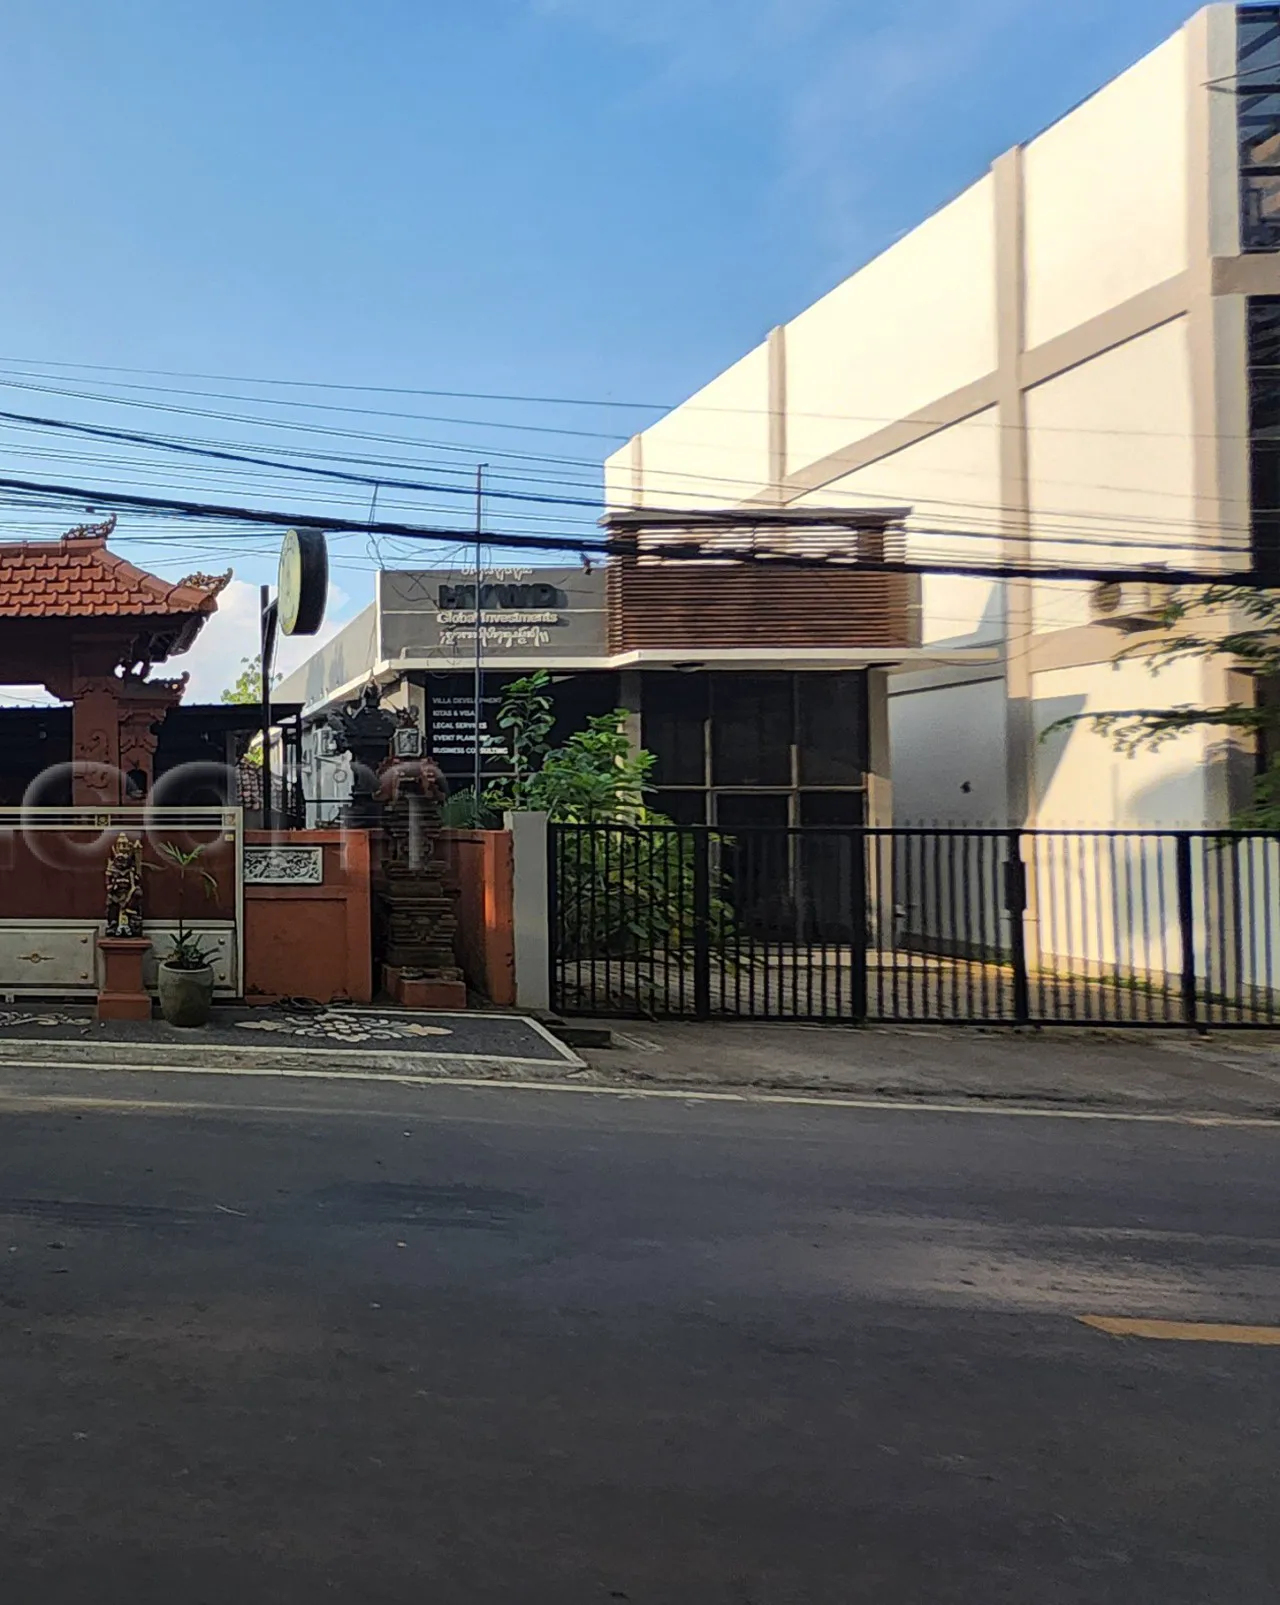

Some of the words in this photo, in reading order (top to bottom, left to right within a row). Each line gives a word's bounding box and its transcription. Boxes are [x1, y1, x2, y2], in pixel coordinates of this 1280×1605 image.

[437, 611, 477, 624] Global
[480, 611, 558, 624] Investments
[432, 709, 452, 717] KITAS
[453, 709, 458, 717] &
[459, 709, 476, 717] VISA
[432, 721, 454, 729] LEGAL
[432, 734, 455, 742] EVENT
[432, 746, 465, 754] BUSINESS
[465, 746, 509, 755] COSULTING
